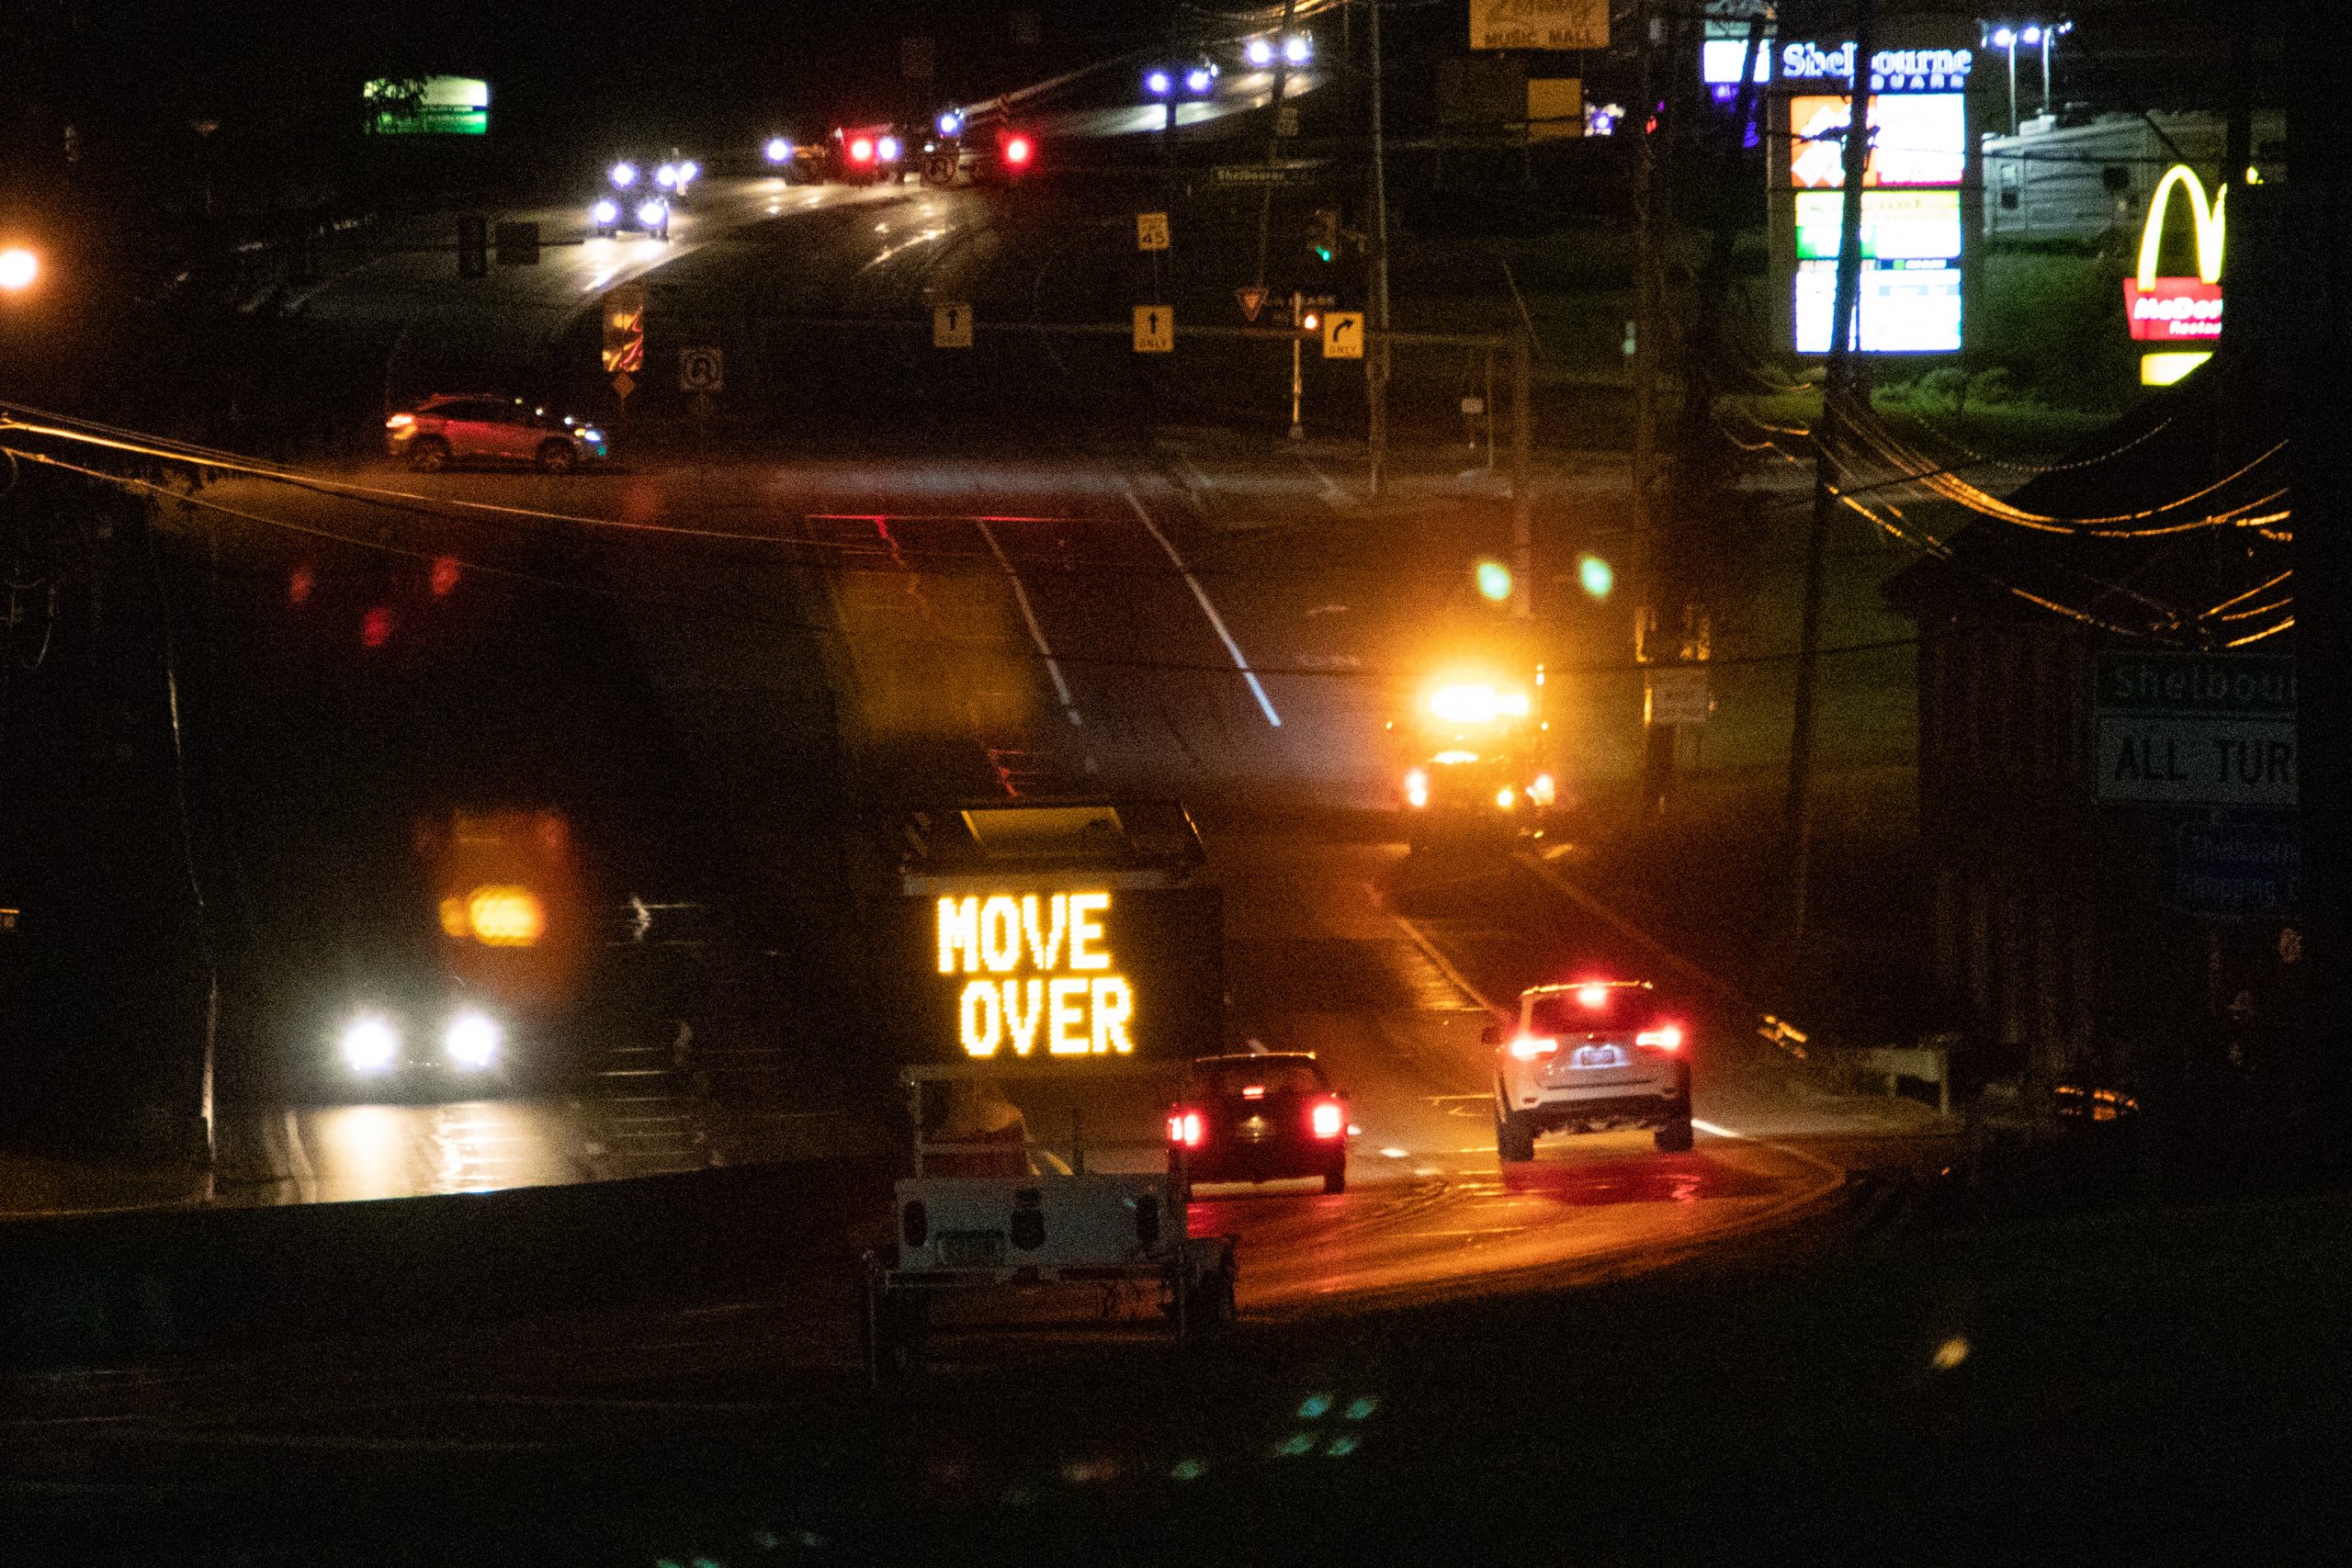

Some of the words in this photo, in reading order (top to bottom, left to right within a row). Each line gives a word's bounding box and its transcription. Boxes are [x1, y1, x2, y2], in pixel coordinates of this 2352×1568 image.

[1782, 41, 1973, 77] Shelourne
[1142, 231, 1166, 245] 45
[1329, 345, 1357, 355] ONLY
[2115, 735, 2188, 782] ALL
[2213, 738, 2291, 785] TUR
[937, 892, 1112, 974] MOVE
[959, 976, 1135, 1057] OVER
